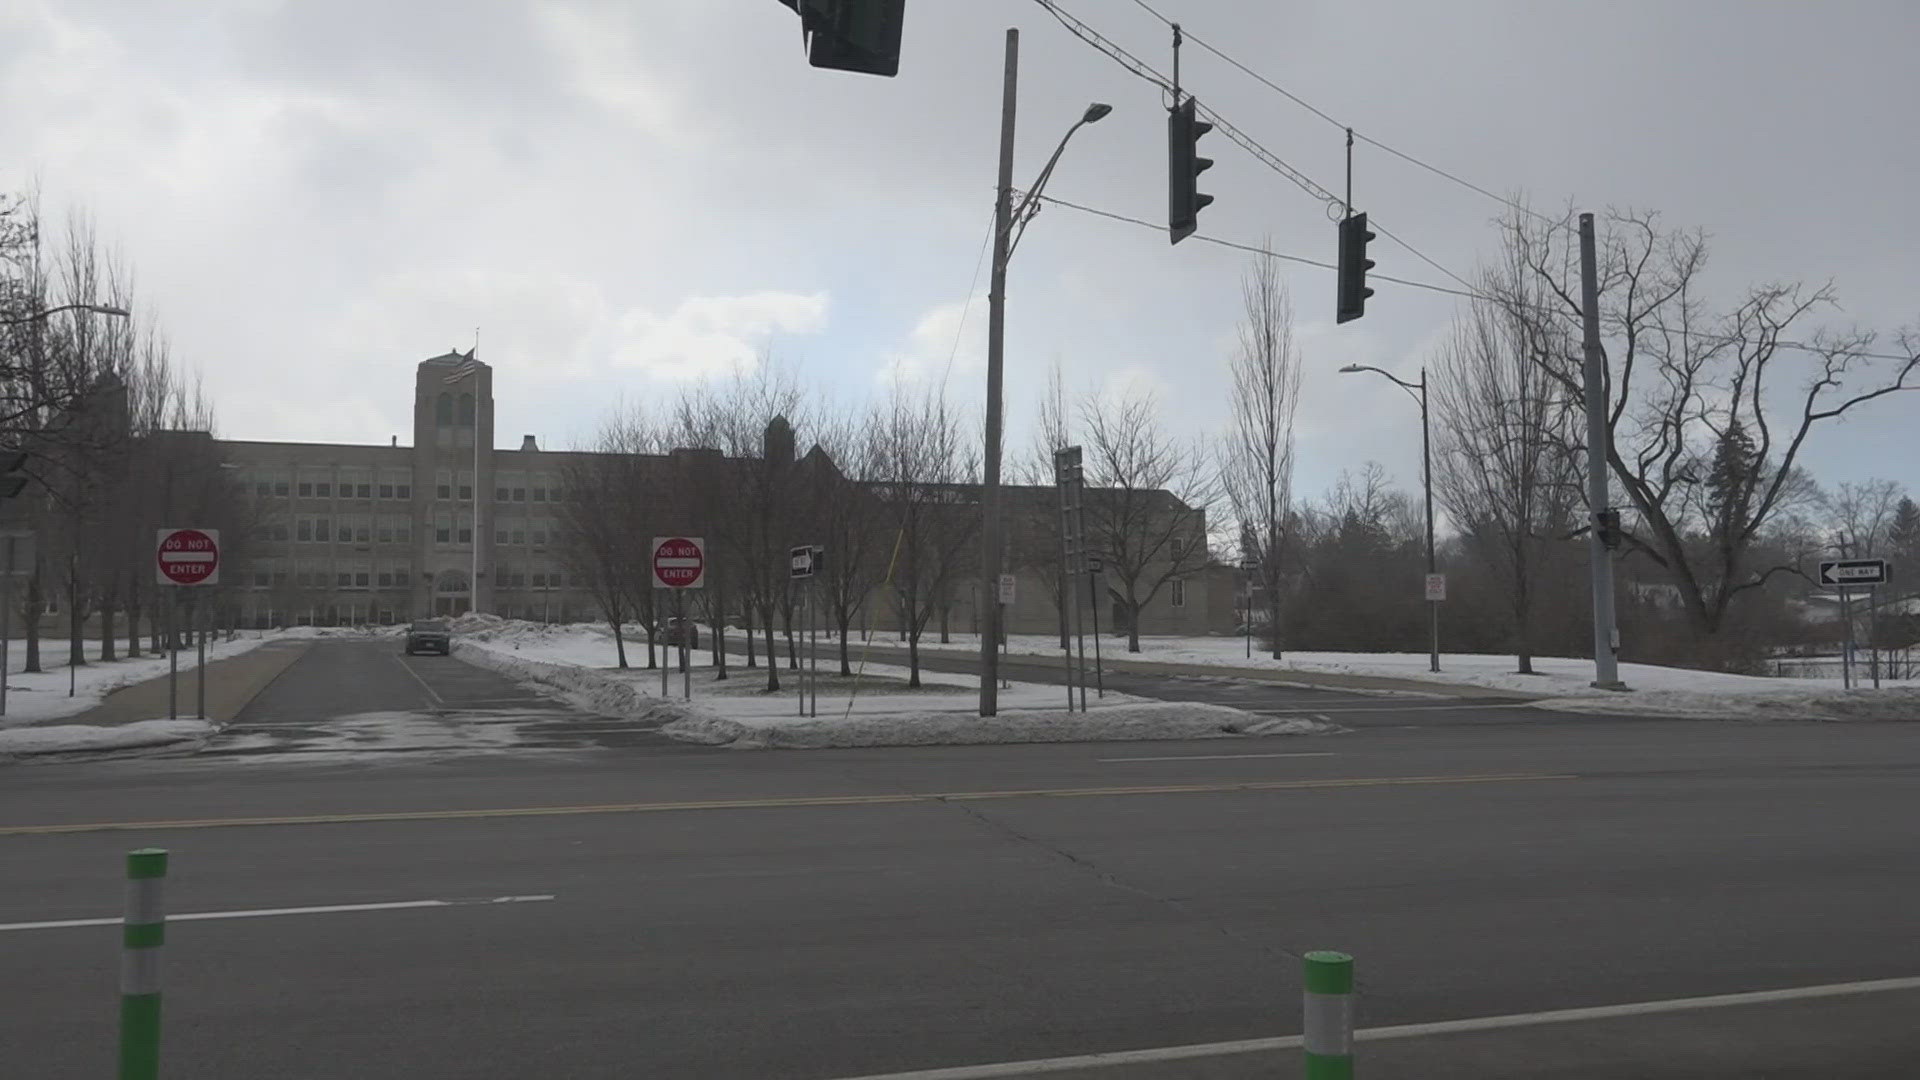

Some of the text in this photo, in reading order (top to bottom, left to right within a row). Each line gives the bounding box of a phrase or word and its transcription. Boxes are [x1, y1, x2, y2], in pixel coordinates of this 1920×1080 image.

[167, 540, 209, 549] DO NOT
[660, 547, 696, 556] DO NOT
[170, 564, 205, 574] ENTER
[1858, 568, 1875, 576] WAY
[664, 570, 693, 578] ENTER
